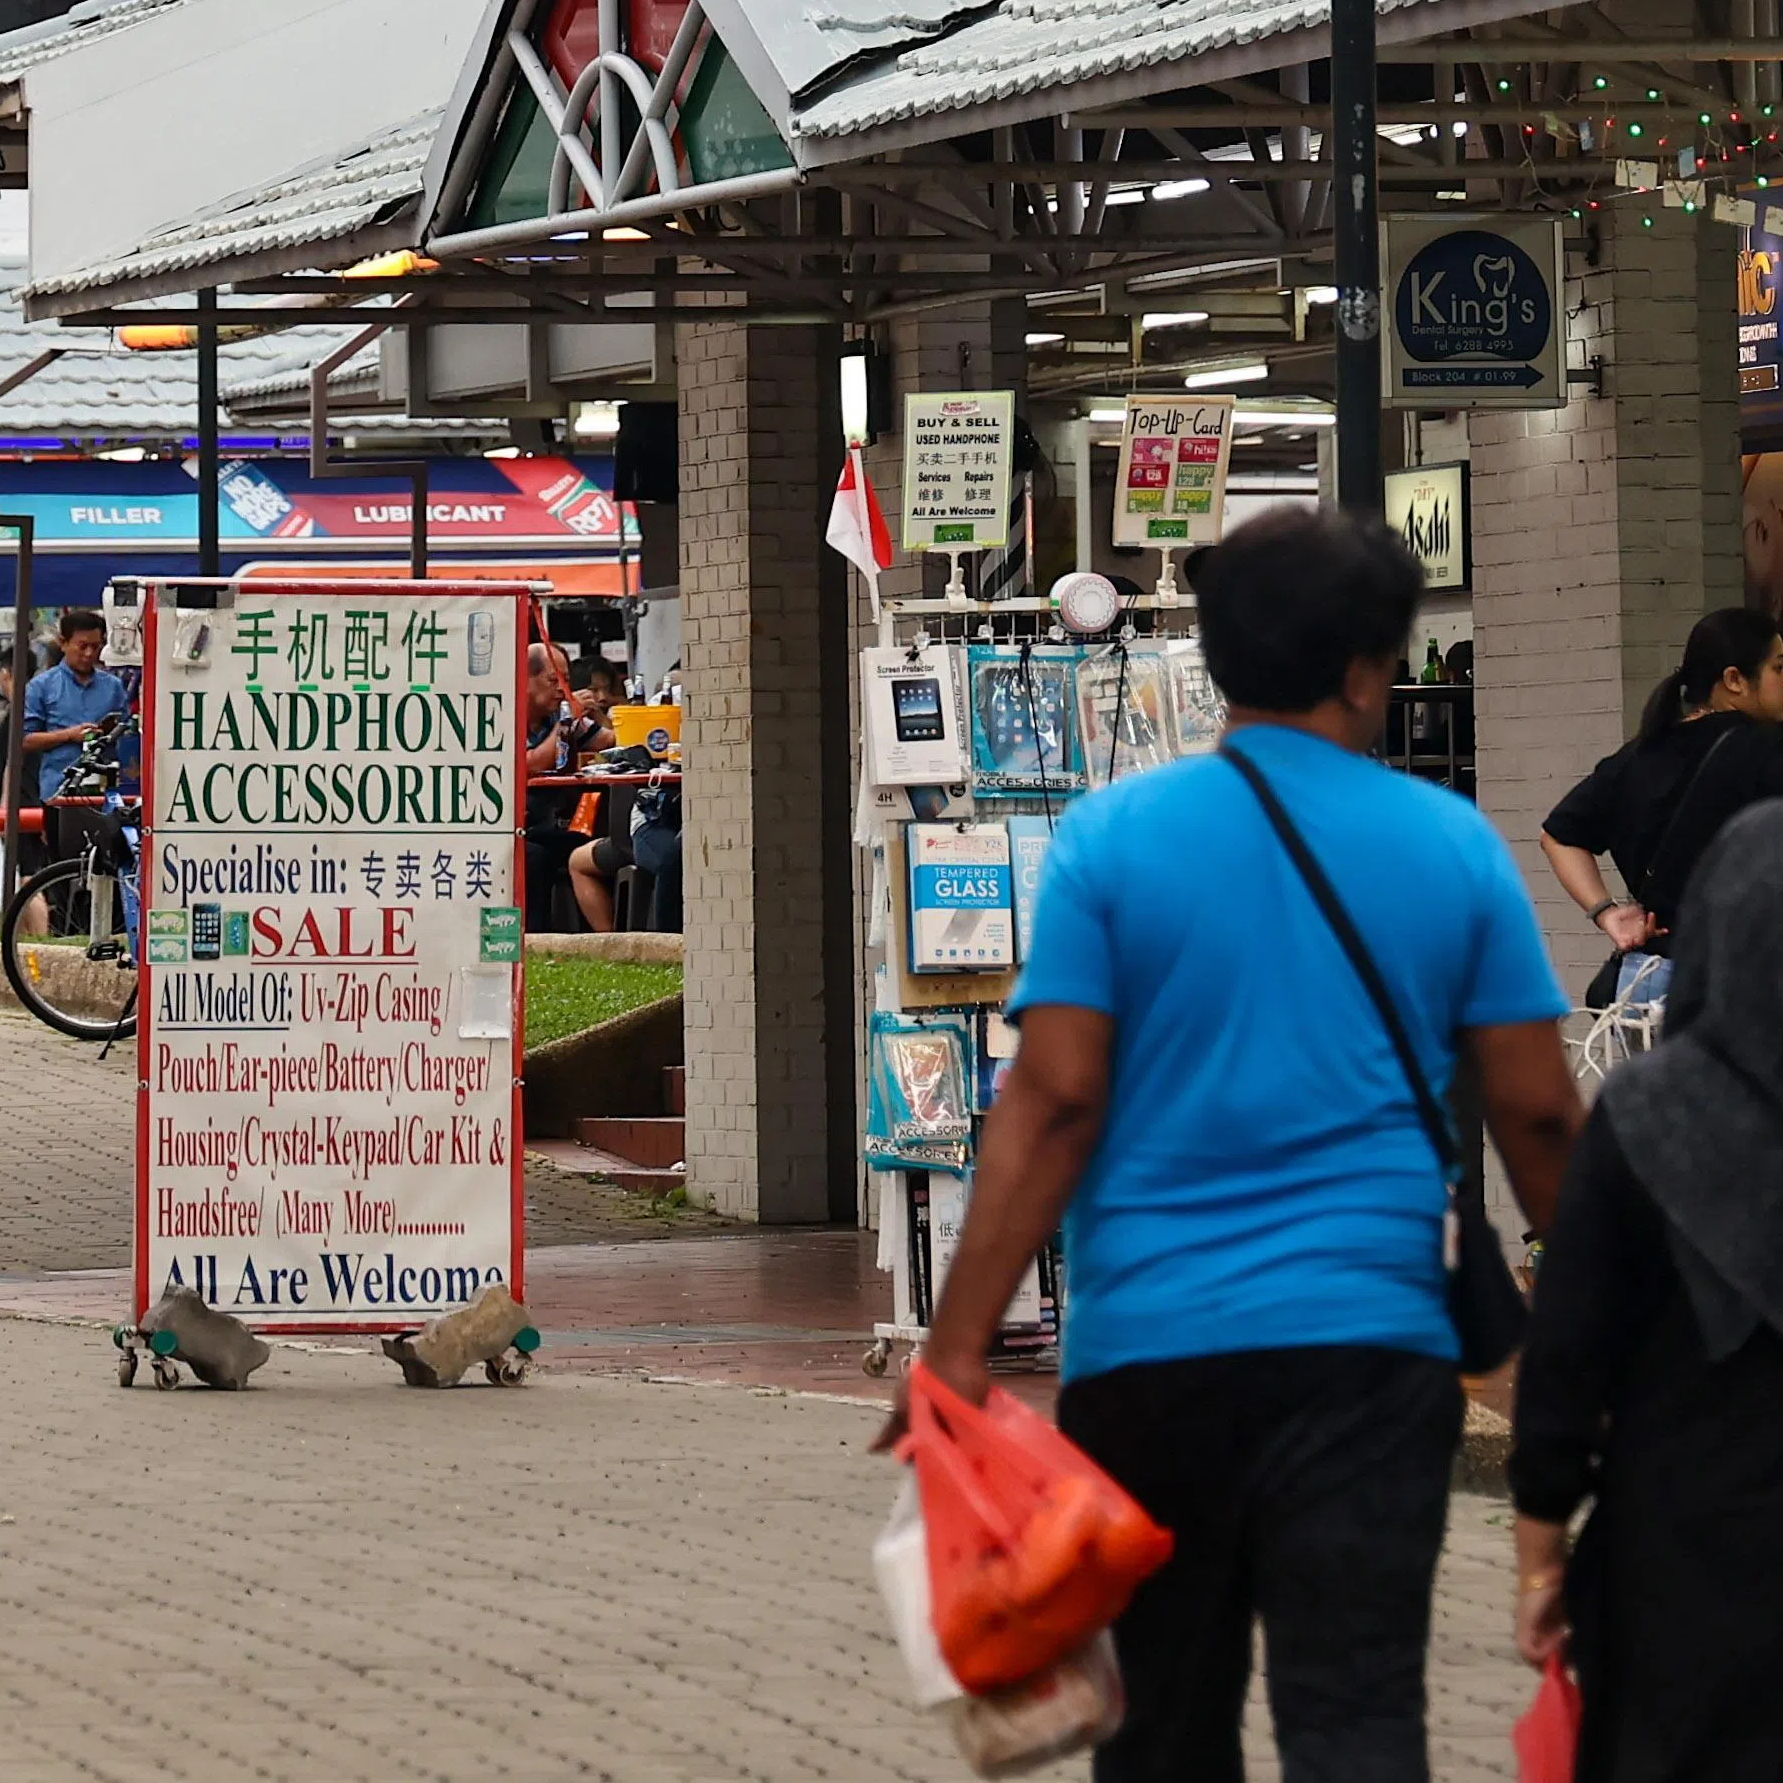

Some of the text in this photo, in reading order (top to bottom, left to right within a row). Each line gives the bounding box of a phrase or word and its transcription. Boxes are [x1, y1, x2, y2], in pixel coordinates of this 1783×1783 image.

[1410, 271, 1535, 336] King's
[1412, 325, 1484, 337] Dental Surgery
[1455, 340, 1482, 351] 6288
[1412, 371, 1441, 382] Block
[1445, 371, 1466, 382] 204
[1484, 371, 1517, 382] 01-99
[918, 418, 1000, 428] BUY & SELL
[917, 434, 1000, 445] USED HANDPHONE
[917, 451, 997, 466] 买卖二手手机
[918, 471, 994, 483] Services Repairs
[70, 507, 162, 525] FILLER
[353, 504, 506, 523] LUBICANT
[912, 506, 996, 516] All Are Welcome
[1402, 493, 1450, 559] Asahi
[231, 608, 448, 684] 手机配件
[877, 664, 934, 674] Screen Protector
[169, 691, 504, 752] HANDPHONE
[166, 763, 504, 825] ACCESSORIES
[877, 793, 892, 803] 4H
[162, 843, 348, 908] Specialise in:
[935, 868, 998, 878] TEMPERED
[935, 879, 998, 897] GLASS
[251, 906, 418, 959] SALE
[159, 972, 187, 1023] All
[193, 972, 254, 1023] Model
[261, 972, 292, 1023] Of:
[300, 972, 369, 1033] Uv-Zip
[375, 972, 442, 1037] Casing
[157, 1041, 492, 1107] Pouch/Ear-piece/Battery/Charger/
[158, 1115, 505, 1181] Housing/Crystal-Keypad/Car Kit &
[158, 1186, 264, 1238] Handsfree/
[276, 1190, 334, 1247] (Many
[234, 1254, 308, 1305] Are
